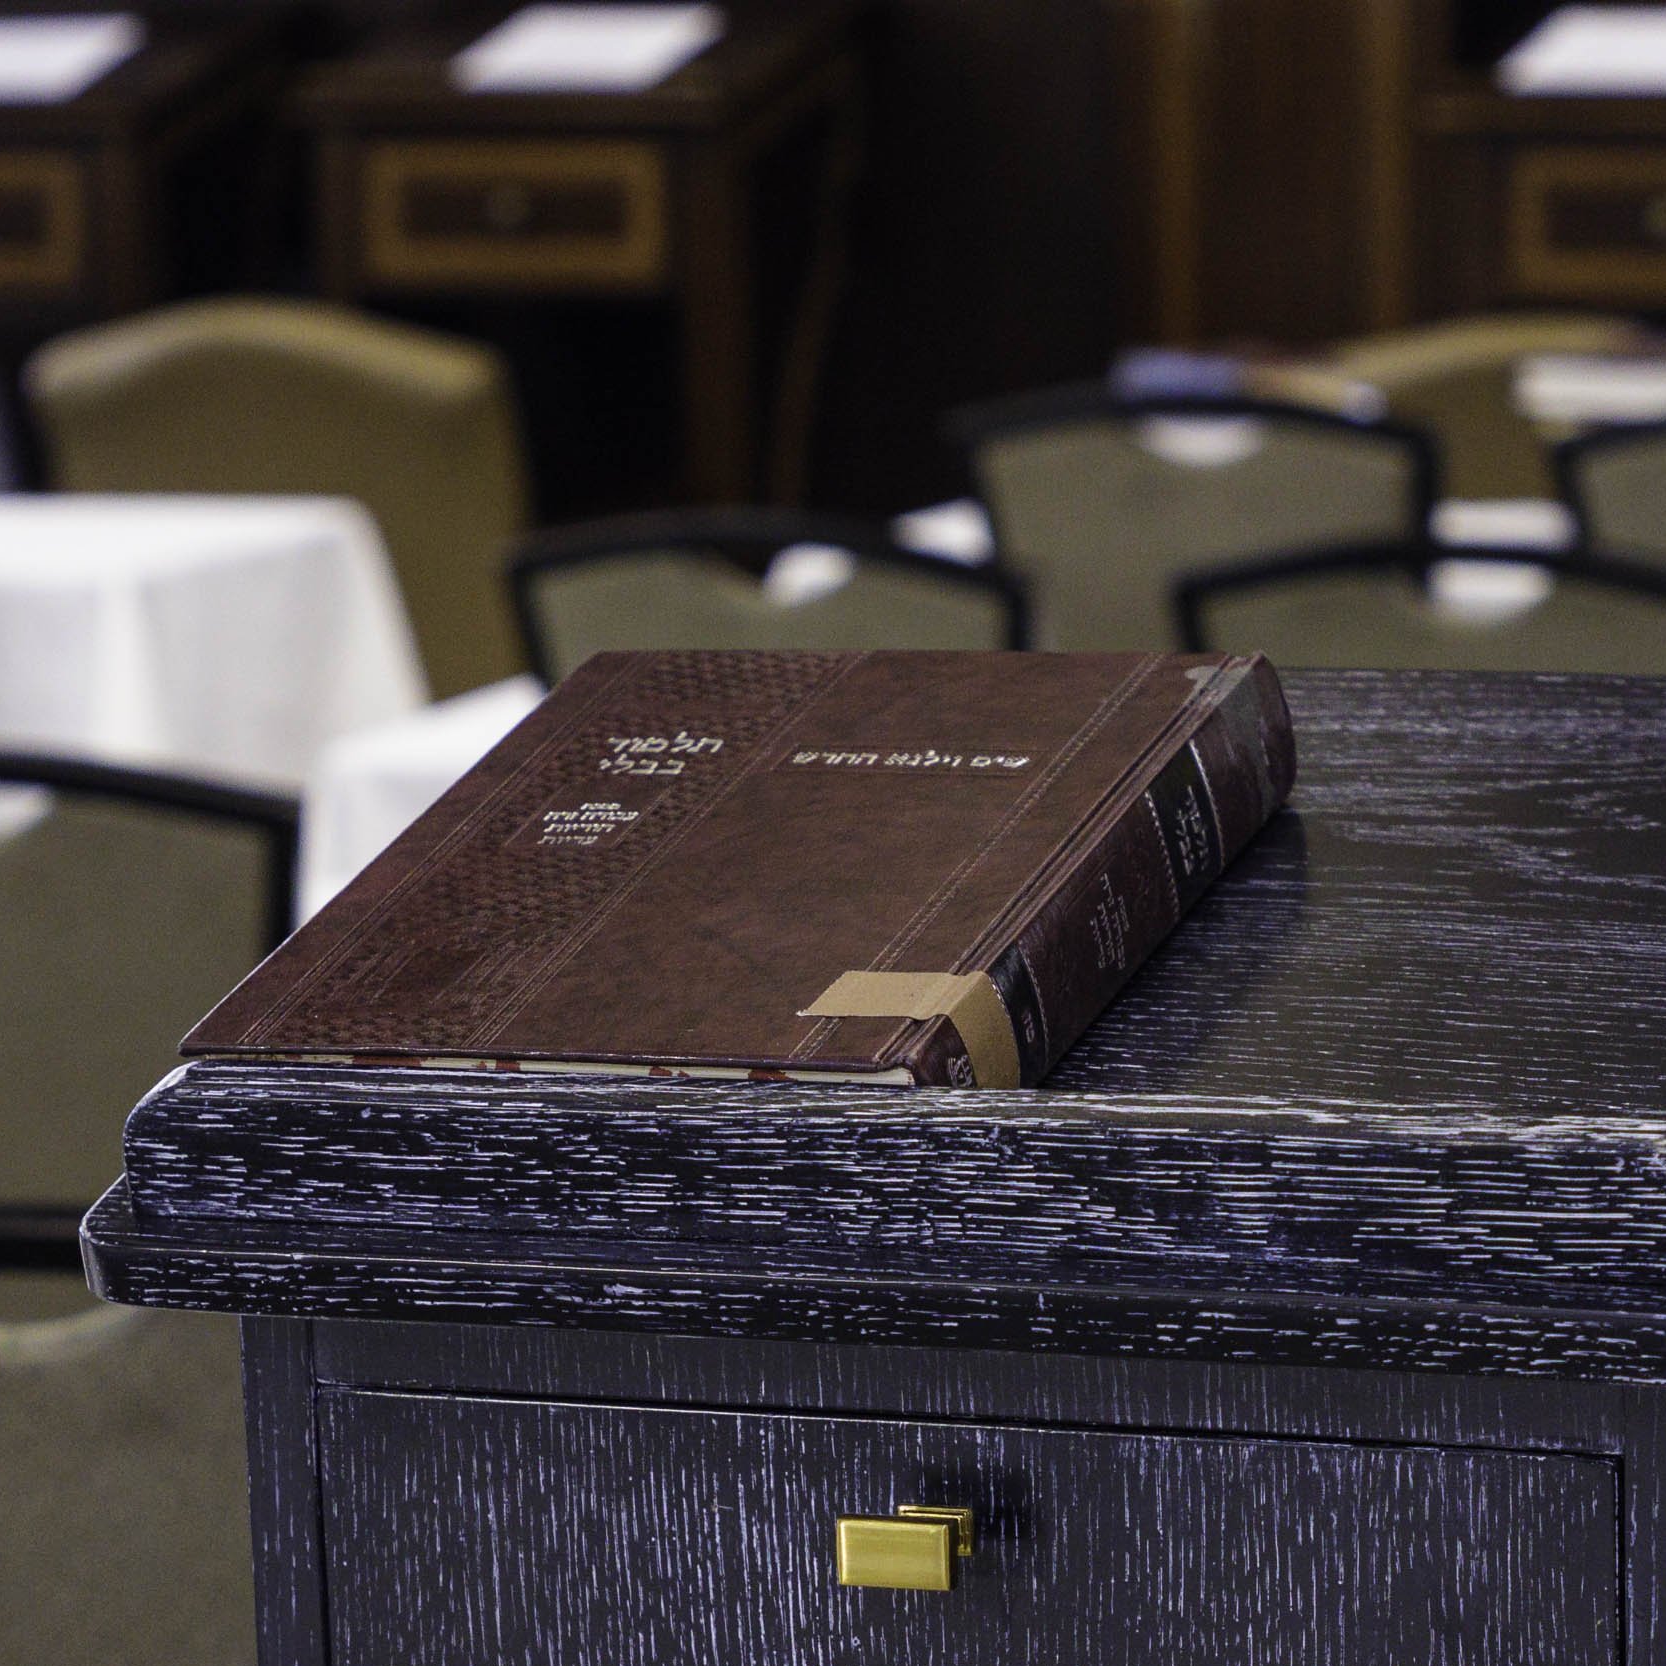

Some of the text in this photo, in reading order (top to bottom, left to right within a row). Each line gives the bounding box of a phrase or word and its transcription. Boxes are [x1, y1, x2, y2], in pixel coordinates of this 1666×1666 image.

[608, 731, 724, 753] תלמוד
[599, 753, 685, 774] בבלי
[793, 751, 879, 765] החדש
[884, 750, 963, 767] וילנא
[542, 811, 639, 821] עבודה זרה
[544, 823, 616, 833] הוריות
[537, 835, 598, 845] עדיות
